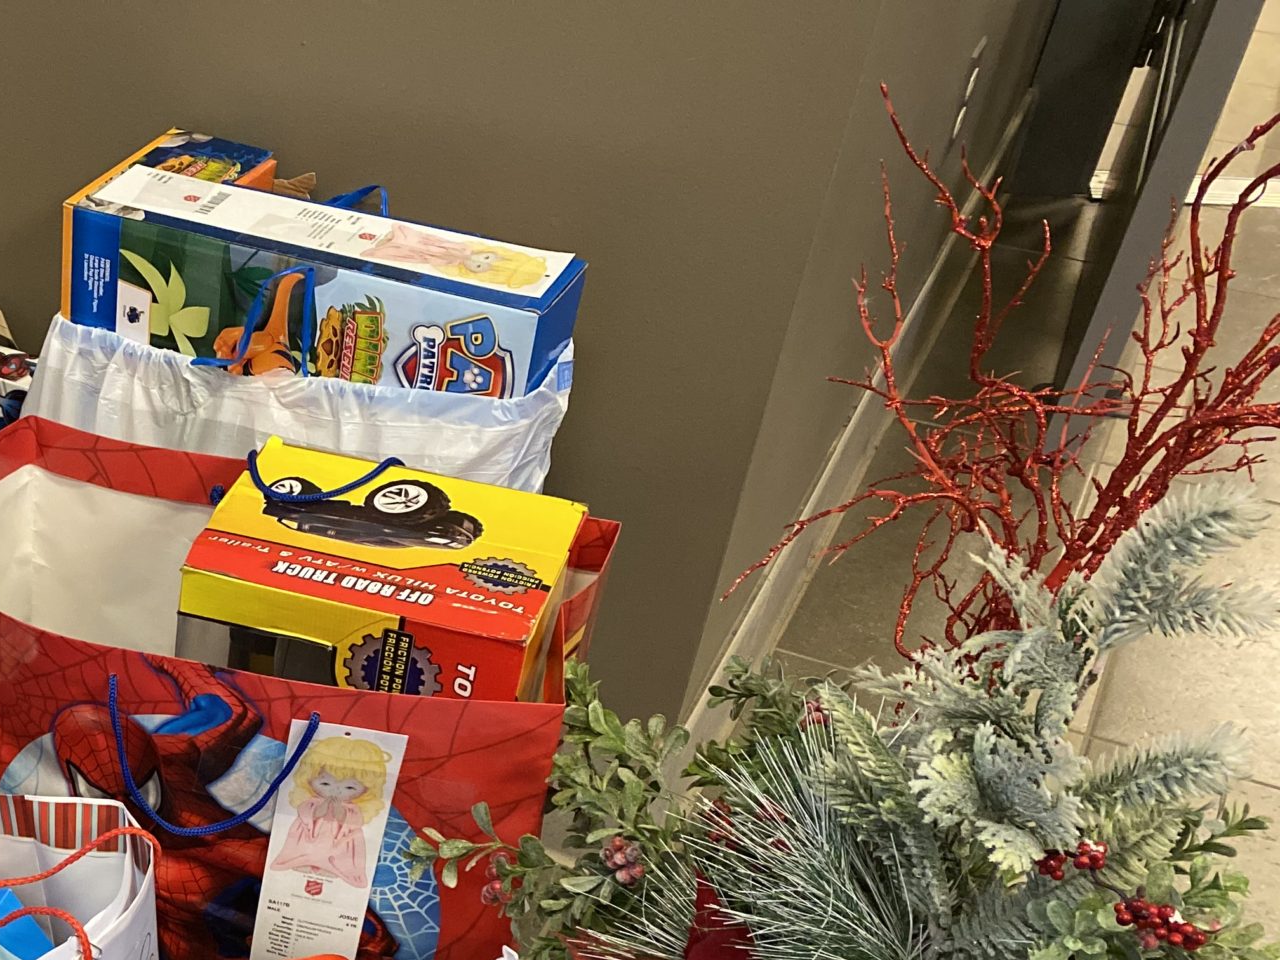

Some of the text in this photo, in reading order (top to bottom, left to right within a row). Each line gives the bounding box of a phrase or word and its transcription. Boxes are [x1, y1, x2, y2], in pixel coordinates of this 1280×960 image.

[340, 318, 357, 381] RESCU
[354, 312, 382, 384] DIN
[447, 313, 498, 393] PA
[272, 560, 435, 606] OFF ROAD TRUCK
[372, 570, 438, 590] HILUX
[445, 586, 526, 614] TOYOTA
[395, 636, 410, 676] FRICTION
